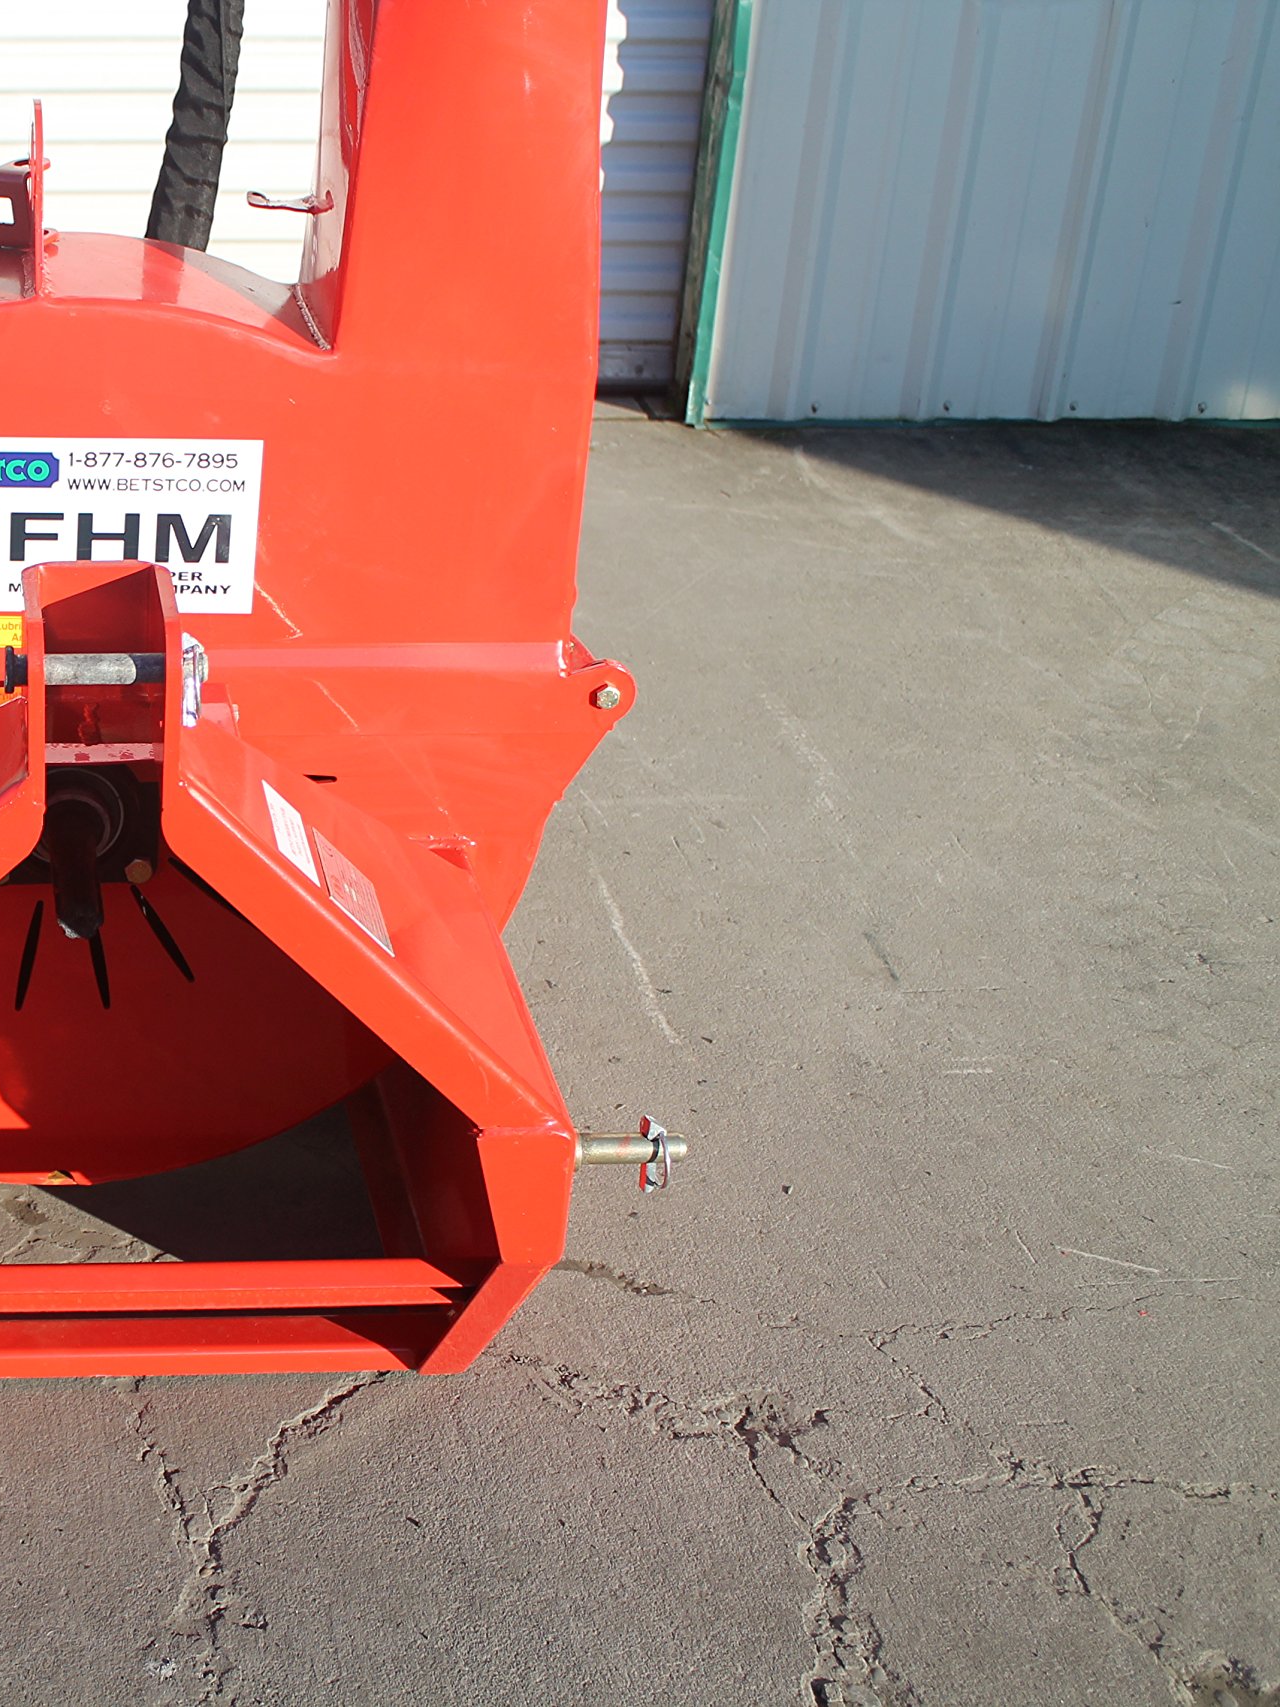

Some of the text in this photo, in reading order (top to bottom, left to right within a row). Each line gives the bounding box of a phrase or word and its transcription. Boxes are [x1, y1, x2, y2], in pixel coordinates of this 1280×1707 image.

[68, 452, 239, 469] 1-877-876-7895
[67, 477, 246, 493] WWW.BETSTCO.COM
[8, 512, 233, 564] FHM
[174, 584, 232, 595] PANY
